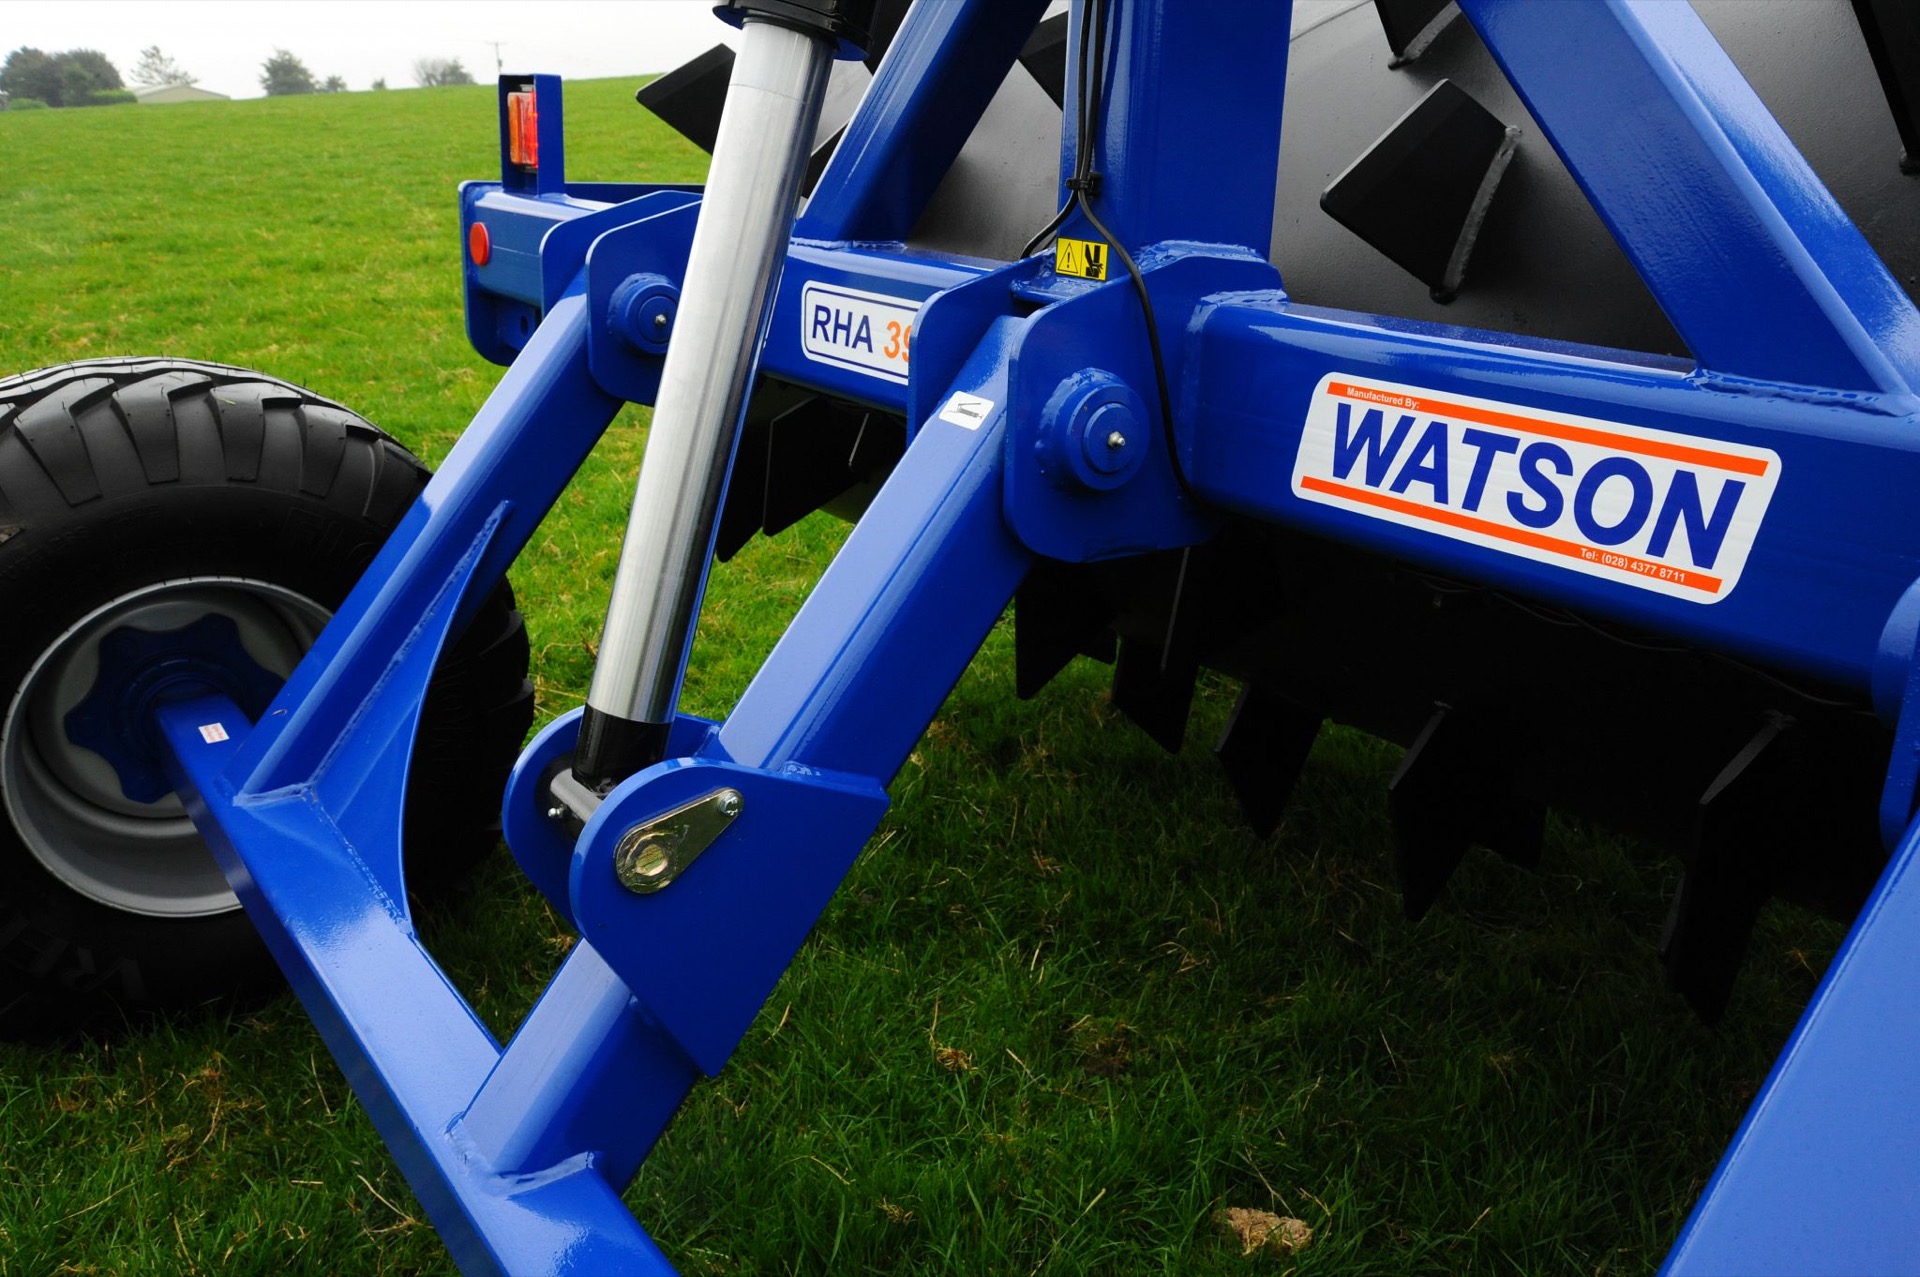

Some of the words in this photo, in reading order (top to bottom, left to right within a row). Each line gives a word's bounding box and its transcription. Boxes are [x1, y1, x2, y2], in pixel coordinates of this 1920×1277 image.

[812, 304, 873, 353] RHA
[1347, 387, 1403, 405] Manufactured
[1405, 398, 1420, 410] By:
[1332, 403, 1746, 569] WATSON
[1581, 548, 1598, 561] Tel:
[1601, 552, 1628, 569] (028)
[1630, 561, 1657, 575] 4377
[1659, 568, 1685, 583] 8711
